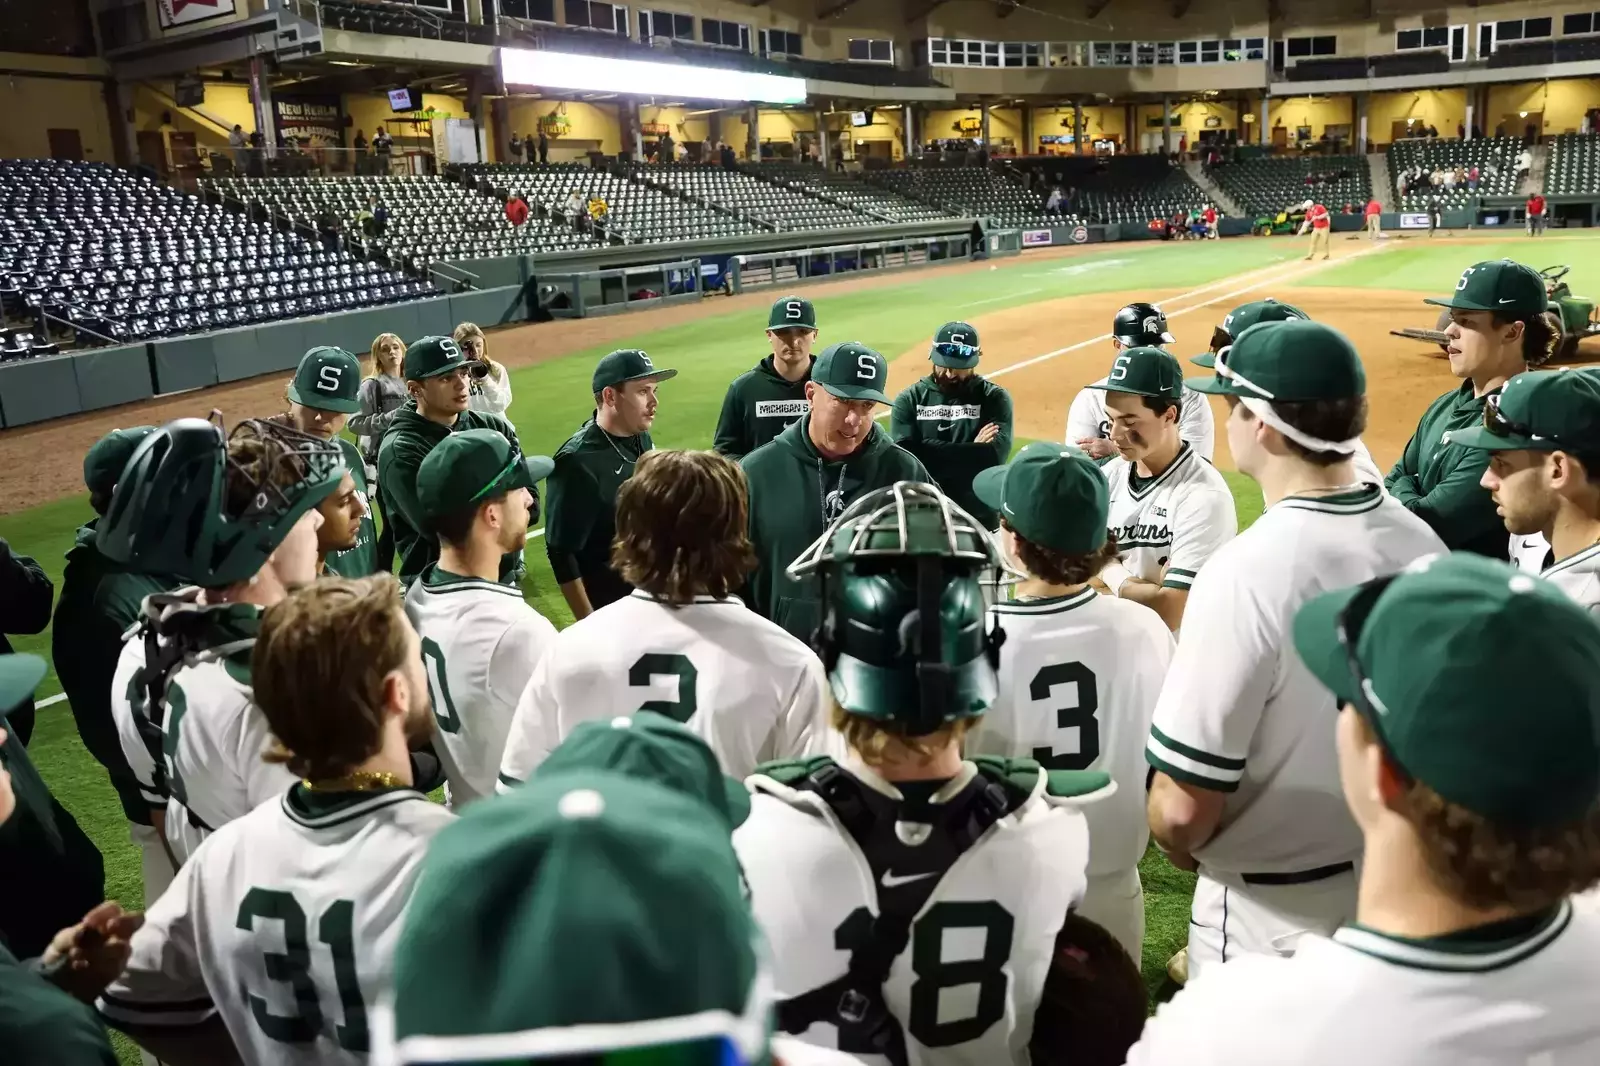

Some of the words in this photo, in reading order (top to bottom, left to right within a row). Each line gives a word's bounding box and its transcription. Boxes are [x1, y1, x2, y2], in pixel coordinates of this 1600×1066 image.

[1455, 267, 1477, 291] S
[786, 302, 802, 319] S
[439, 338, 459, 359] S
[638, 350, 653, 367] S
[317, 365, 342, 392] S
[857, 354, 877, 380] S
[1110, 356, 1132, 381] S
[759, 403, 802, 415] MICHIGAN
[916, 406, 953, 419] MICHIGAN
[954, 406, 979, 418] STATE
[628, 652, 698, 723] 2
[1029, 660, 1100, 771] 3
[236, 885, 370, 1053] 31
